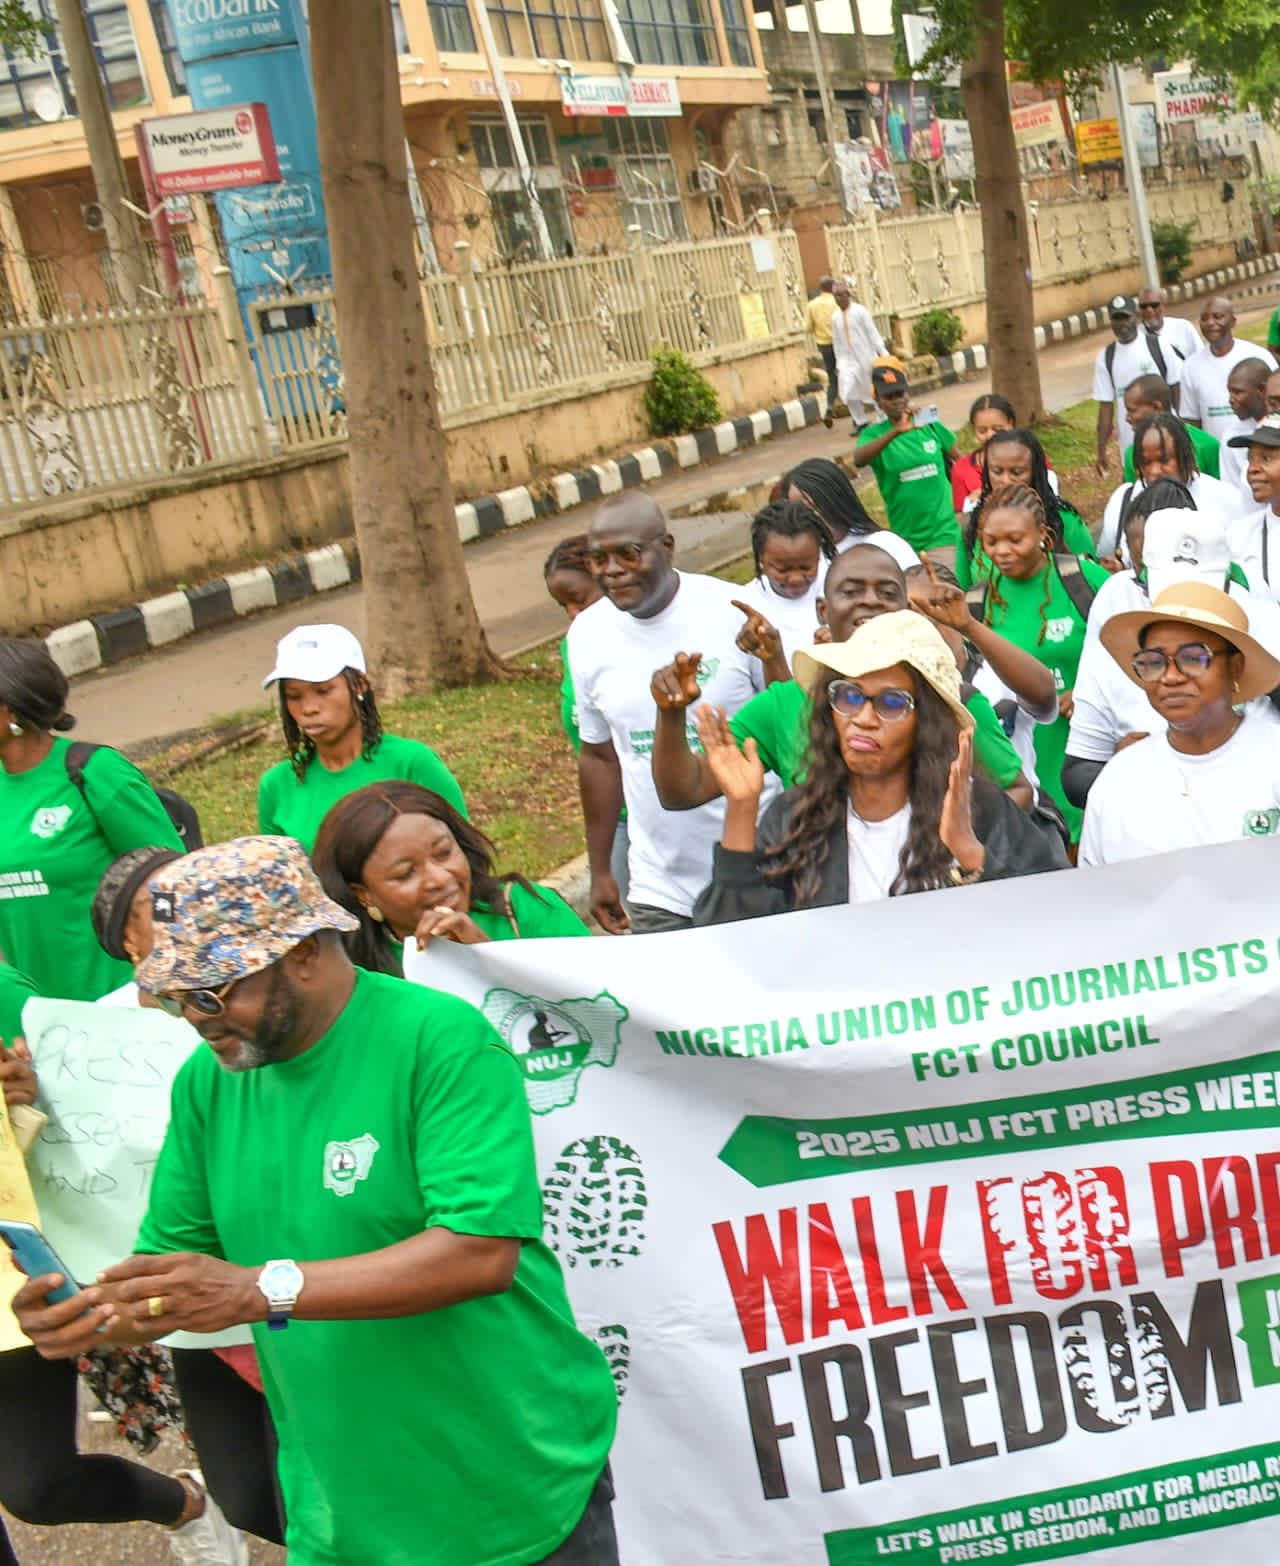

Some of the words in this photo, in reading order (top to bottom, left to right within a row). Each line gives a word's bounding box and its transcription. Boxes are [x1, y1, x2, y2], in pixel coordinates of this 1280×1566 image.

[152, 127, 237, 147] MoneyGram
[655, 1017, 809, 1059] NIGERIA
[816, 995, 937, 1046] UNION
[945, 986, 990, 1026] OF
[1002, 938, 1269, 1017] JOURNALISTS
[526, 1051, 573, 1073] NUJ
[911, 1043, 981, 1082] FCT
[991, 1014, 1161, 1072] COUNCIL
[796, 1128, 901, 1160] 2025
[904, 1117, 984, 1150] NUJ
[988, 1108, 1058, 1140] FCT
[1064, 1084, 1191, 1132] PRESS
[711, 1184, 968, 1354] WALK
[976, 1165, 1140, 1305] FOR
[740, 1278, 1243, 1501] FREEDOM
[875, 1528, 934, 1556] LET'S
[938, 1514, 998, 1544] WALK
[1001, 1509, 1024, 1530] IN
[1028, 1483, 1150, 1526] SOLIDARITY
[1153, 1475, 1194, 1501] FOR
[1197, 1459, 1262, 1492] MEDIA
[938, 1536, 1009, 1565] PRESS
[1012, 1516, 1116, 1549] FREEDOM,
[1118, 1505, 1161, 1532] AND
